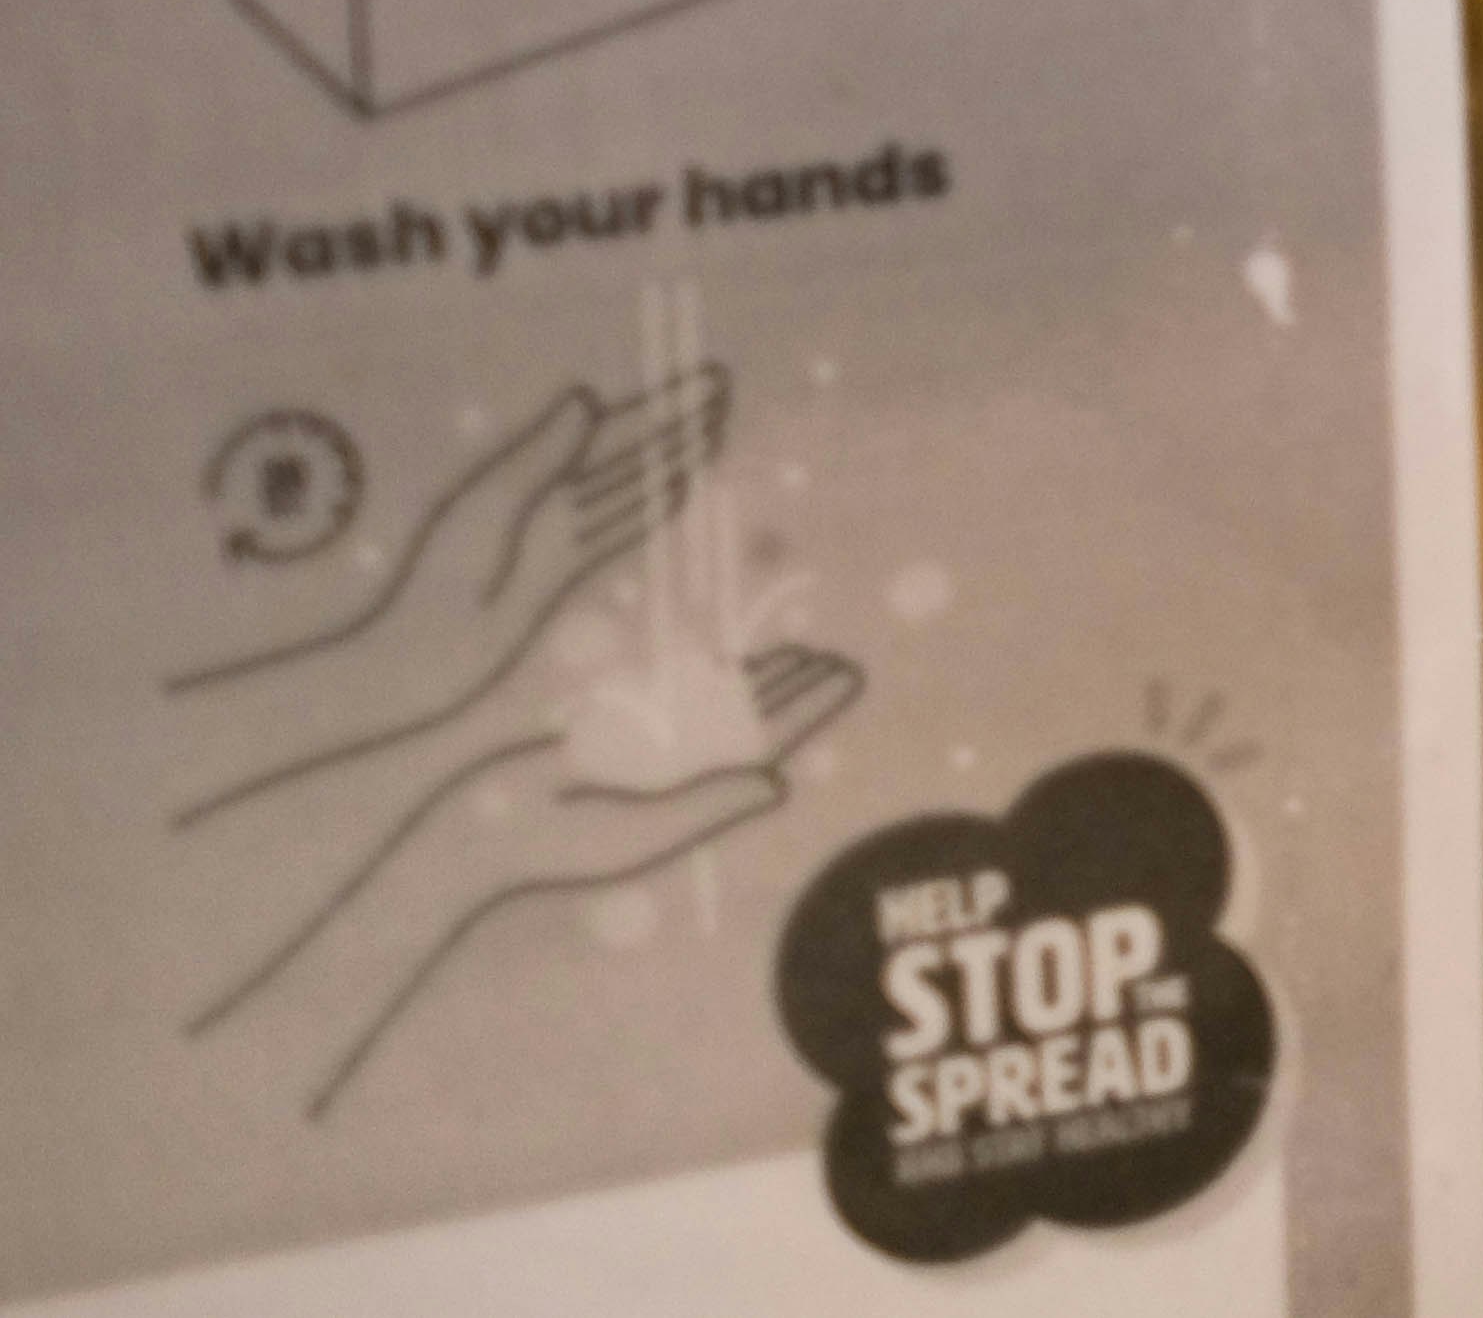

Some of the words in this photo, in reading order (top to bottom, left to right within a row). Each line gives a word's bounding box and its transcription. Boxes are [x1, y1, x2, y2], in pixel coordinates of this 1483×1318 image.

[190, 196, 448, 289] Wash
[462, 180, 667, 280] your
[681, 139, 954, 231] hands
[882, 905, 1163, 1061] STOP
[888, 1015, 1194, 1149] SPREAD
